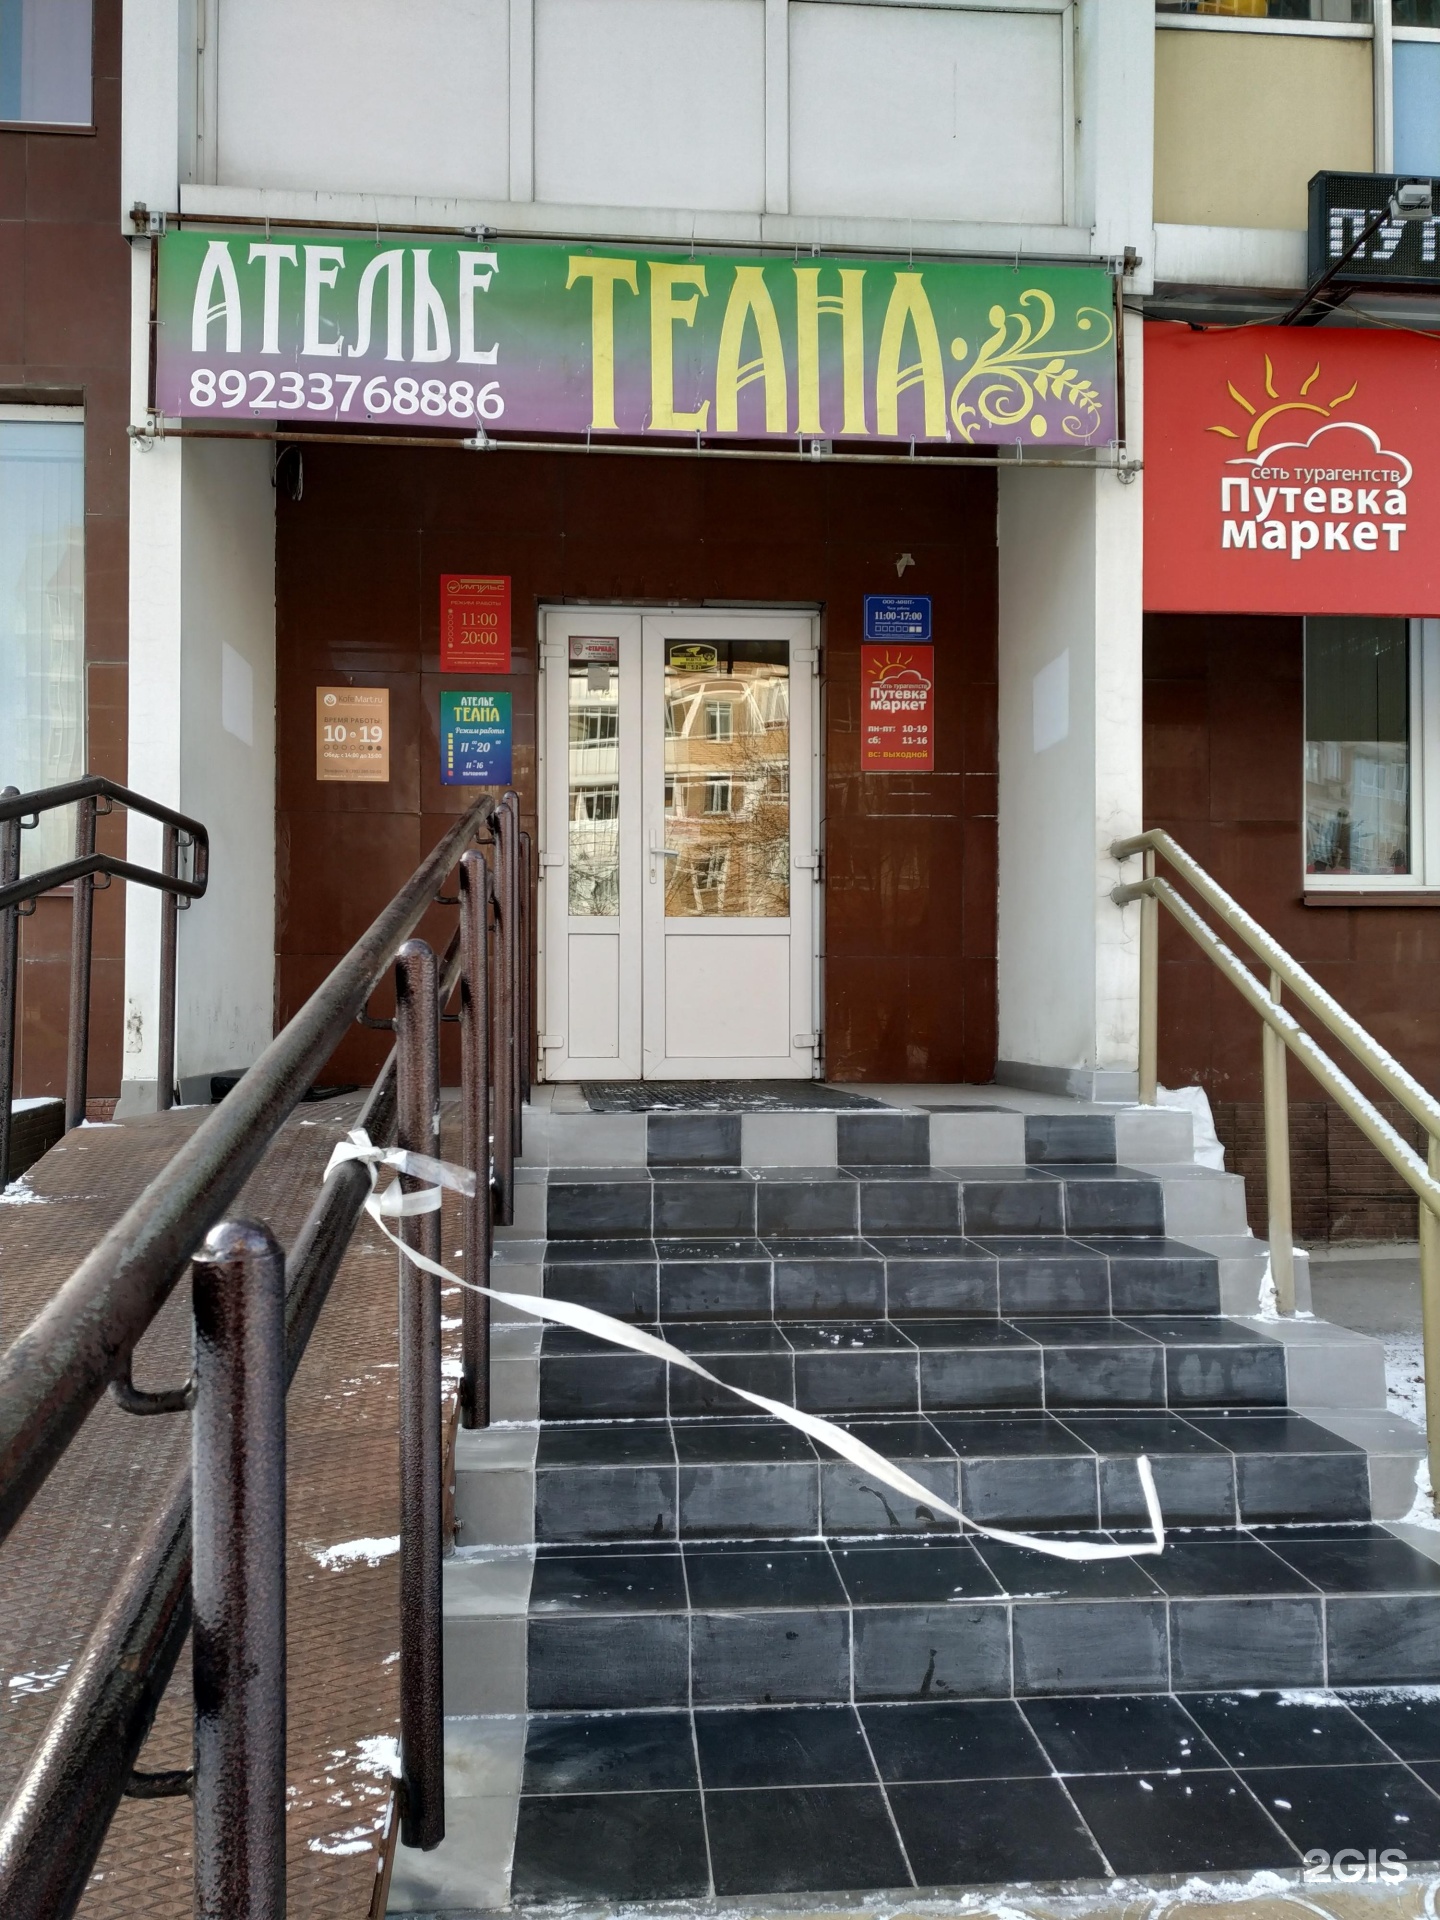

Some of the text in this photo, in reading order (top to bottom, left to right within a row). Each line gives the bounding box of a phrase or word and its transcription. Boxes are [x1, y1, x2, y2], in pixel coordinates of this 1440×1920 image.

[191, 241, 946, 437] АТЕЛЬЕ ТЕАНА
[189, 368, 505, 420] 89233768886
[1251, 466, 1401, 484] сеть турагентств
[1221, 477, 1407, 523] Путевка
[1221, 519, 1407, 560] маркет
[460, 584, 505, 593] ИМПУЛЬС
[461, 612, 498, 626] 11:00
[875, 611, 923, 621] 11:00-17:00
[460, 631, 498, 645] 20:00
[460, 696, 495, 707] АТЕЛЬЕ
[870, 687, 928, 702] Путевка
[453, 706, 500, 722] ТЕАНА
[870, 699, 927, 714] маркет
[323, 724, 383, 743] 10 19
[867, 725, 928, 733] пн-пт: 10-19
[902, 736, 928, 745] 11-16
[883, 750, 928, 759] выходной
